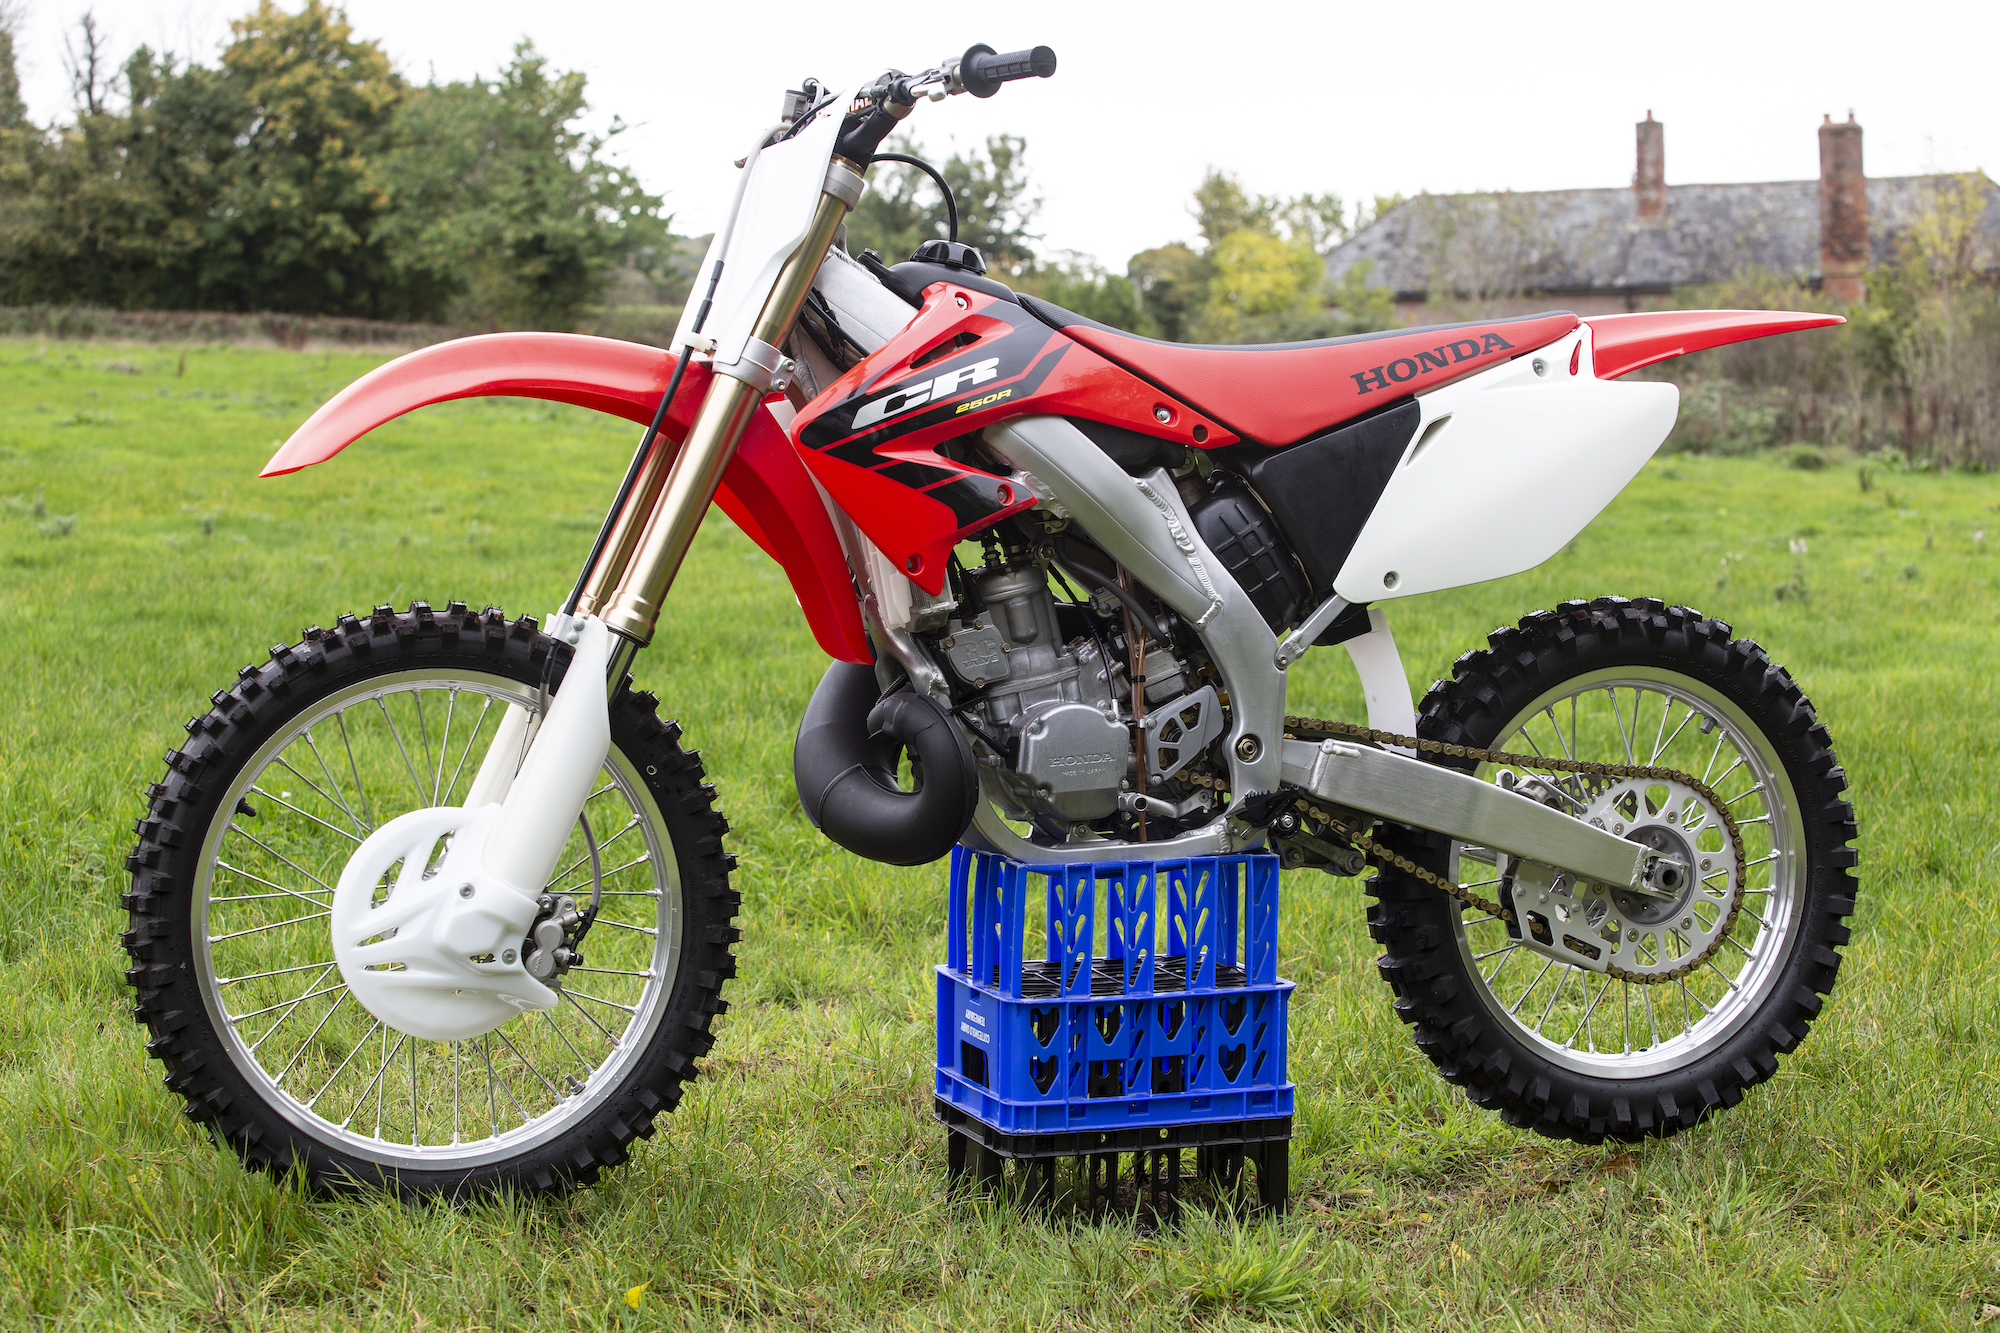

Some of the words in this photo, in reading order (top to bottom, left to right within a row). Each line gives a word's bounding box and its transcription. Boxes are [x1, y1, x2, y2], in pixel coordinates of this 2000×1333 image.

[1350, 333, 1516, 396] HONDA
[851, 357, 1000, 430] CR
[955, 389, 1012, 415] 250R
[961, 655, 999, 670] VALVE
[1049, 752, 1117, 768] HONDA
[1797, 881, 1824, 973] DUNLOP
